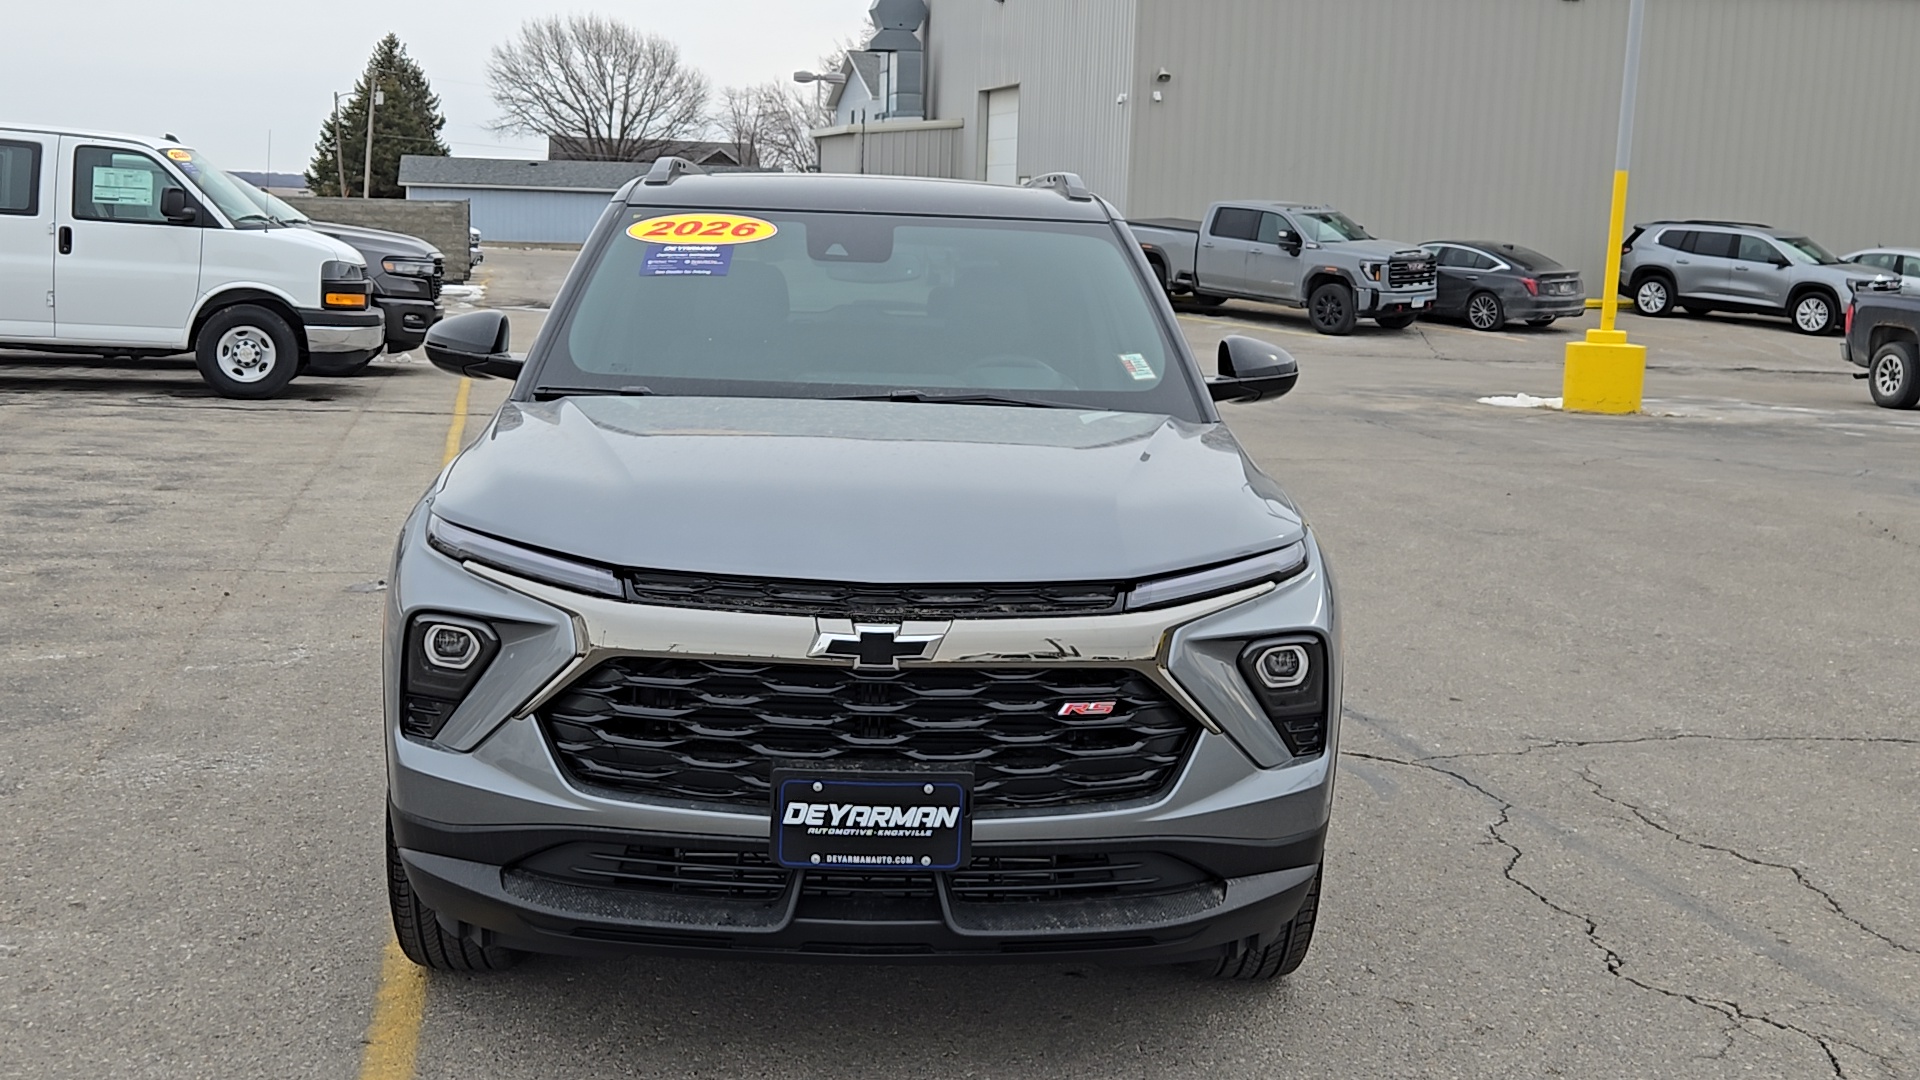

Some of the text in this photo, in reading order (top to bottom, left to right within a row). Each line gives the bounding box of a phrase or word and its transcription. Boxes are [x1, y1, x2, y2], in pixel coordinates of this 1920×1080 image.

[642, 220, 760, 237] 2026
[1057, 701, 1117, 716] RS
[782, 802, 960, 828] DEYARMAN
[807, 827, 933, 837] AUTOMOTIVE KNOXVILLE
[826, 854, 914, 865] DEYARMANAUTO.COM
